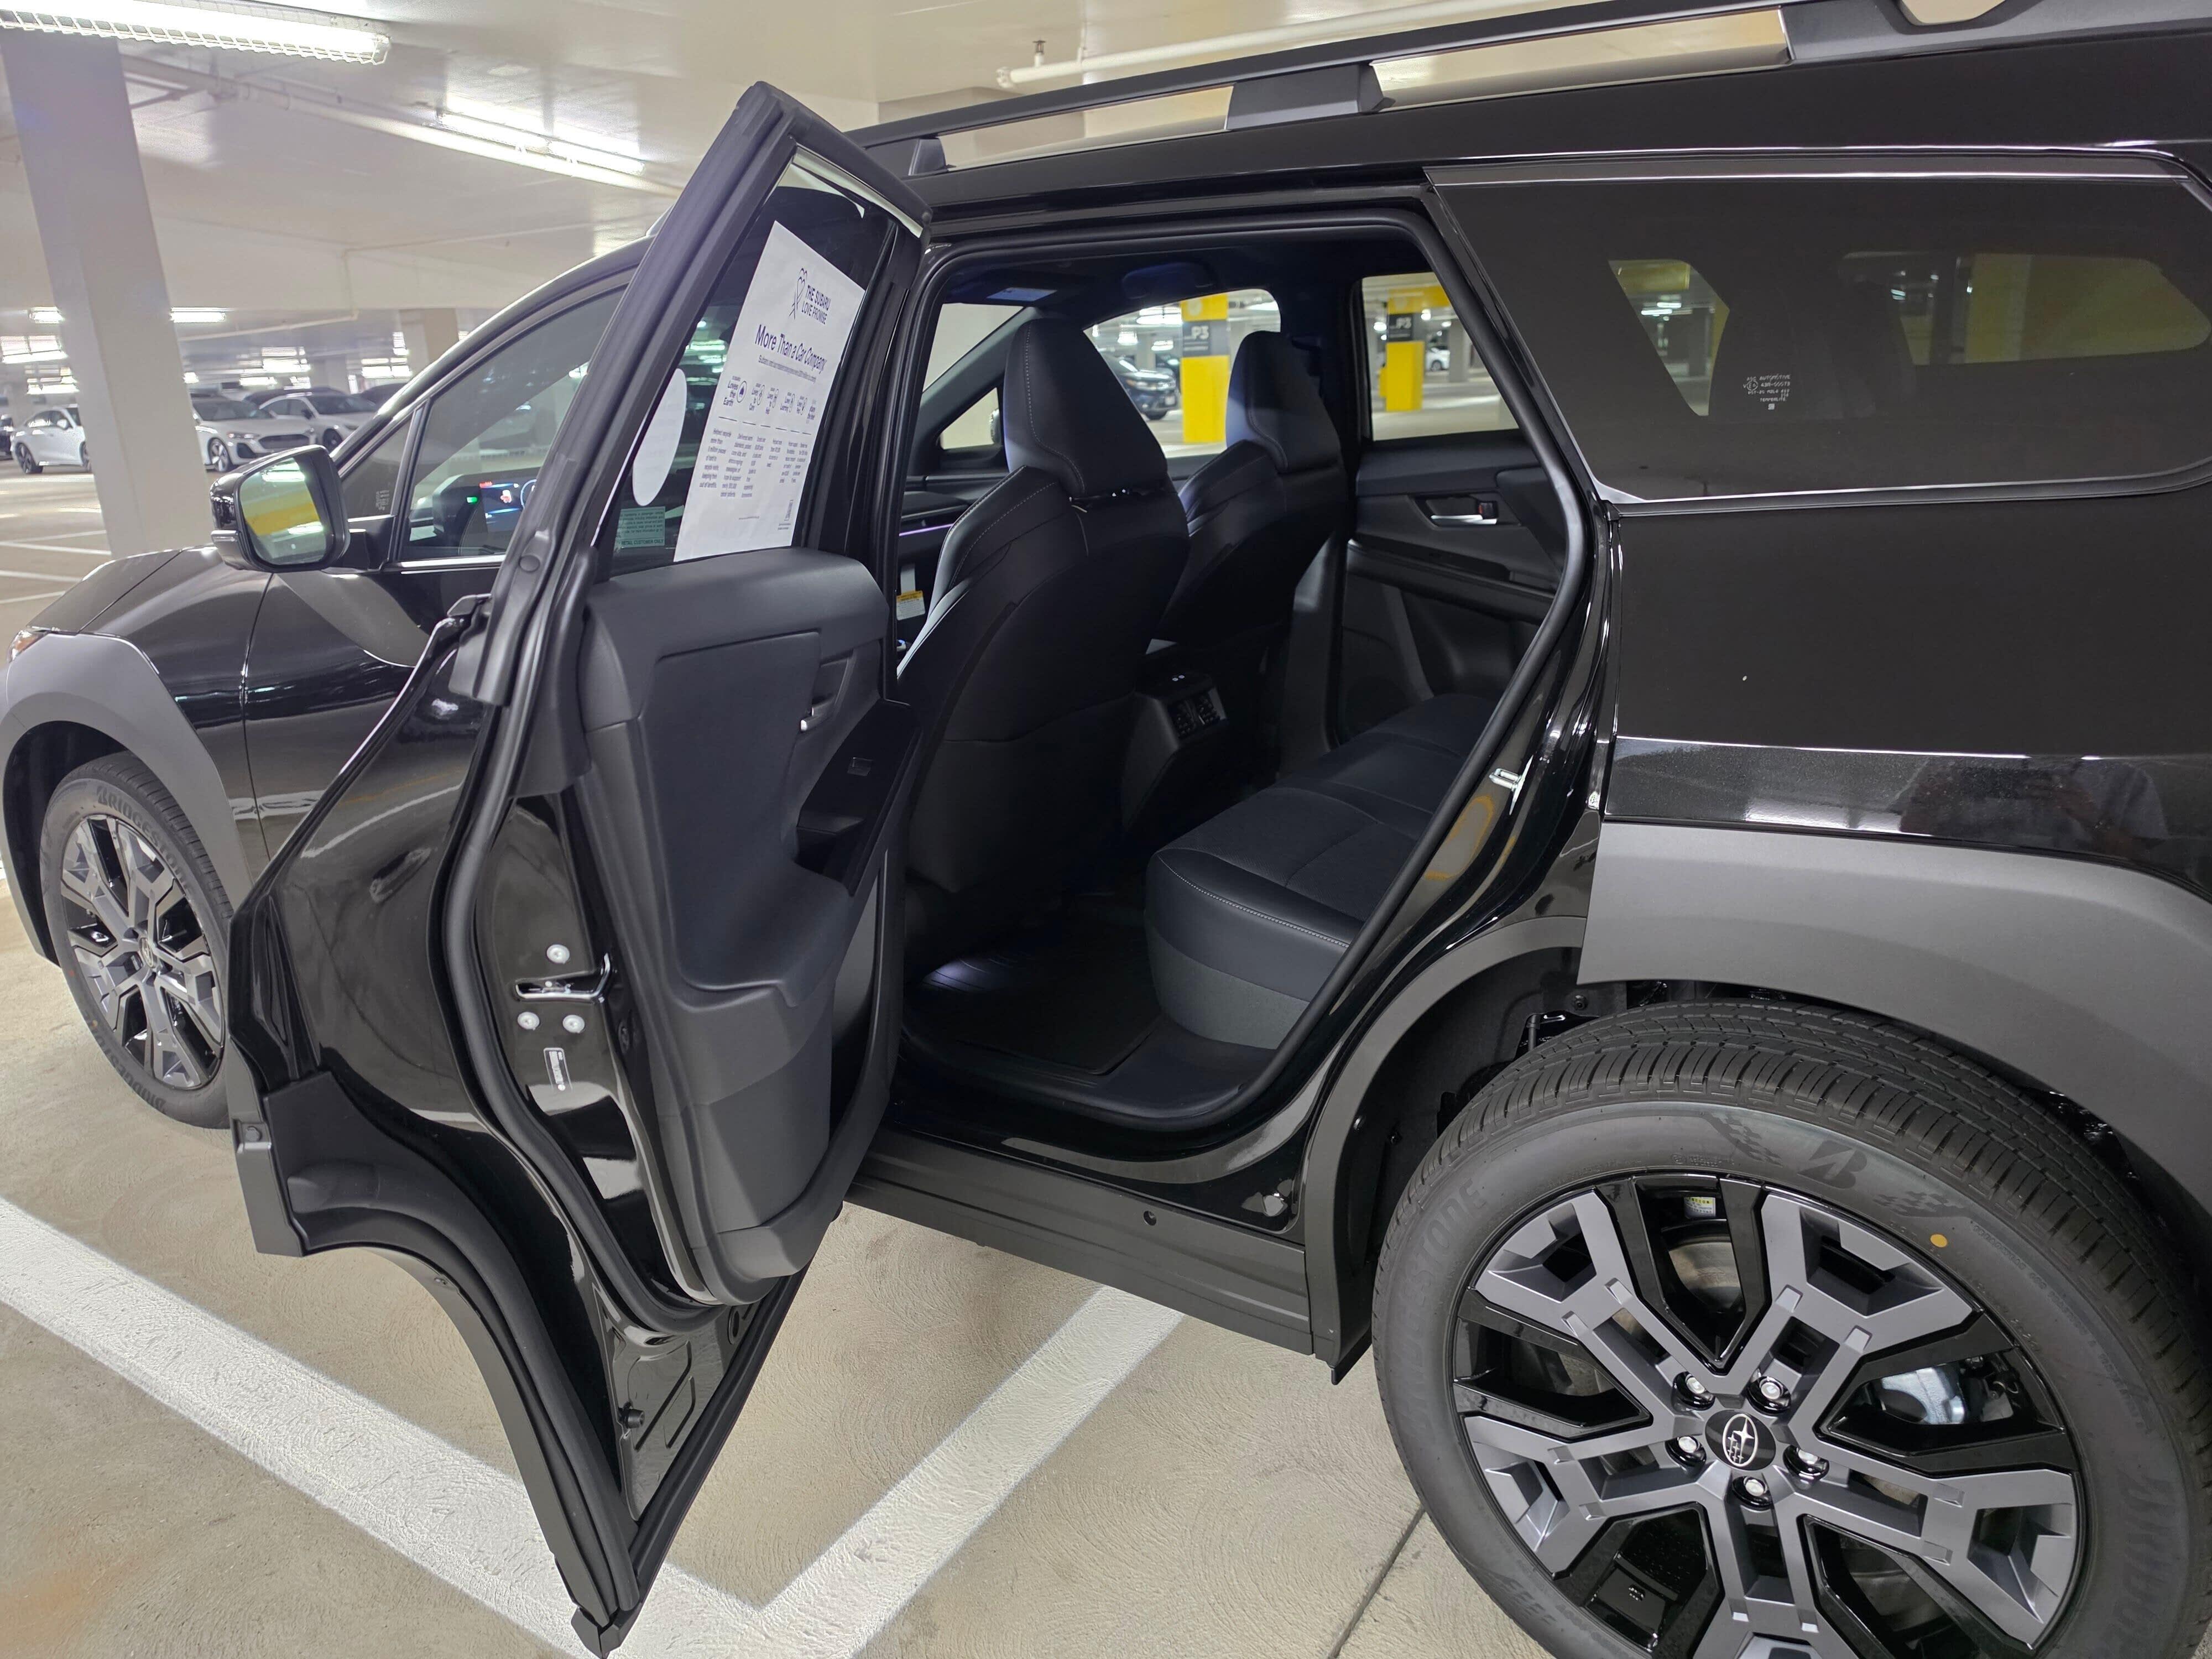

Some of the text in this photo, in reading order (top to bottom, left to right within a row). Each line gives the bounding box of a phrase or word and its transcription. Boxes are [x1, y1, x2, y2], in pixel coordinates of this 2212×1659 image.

[806, 284, 831, 311] THE SUBARU
[801, 301, 827, 325] LOVE PROMISE
[1396, 317, 1412, 330] P3
[1191, 326, 1209, 341] P3
[755, 324, 777, 351] More
[777, 333, 792, 357] Than
[791, 345, 797, 358] a
[795, 343, 806, 362] Car
[728, 380, 738, 390] Loves
[723, 397, 733, 407] Earth
